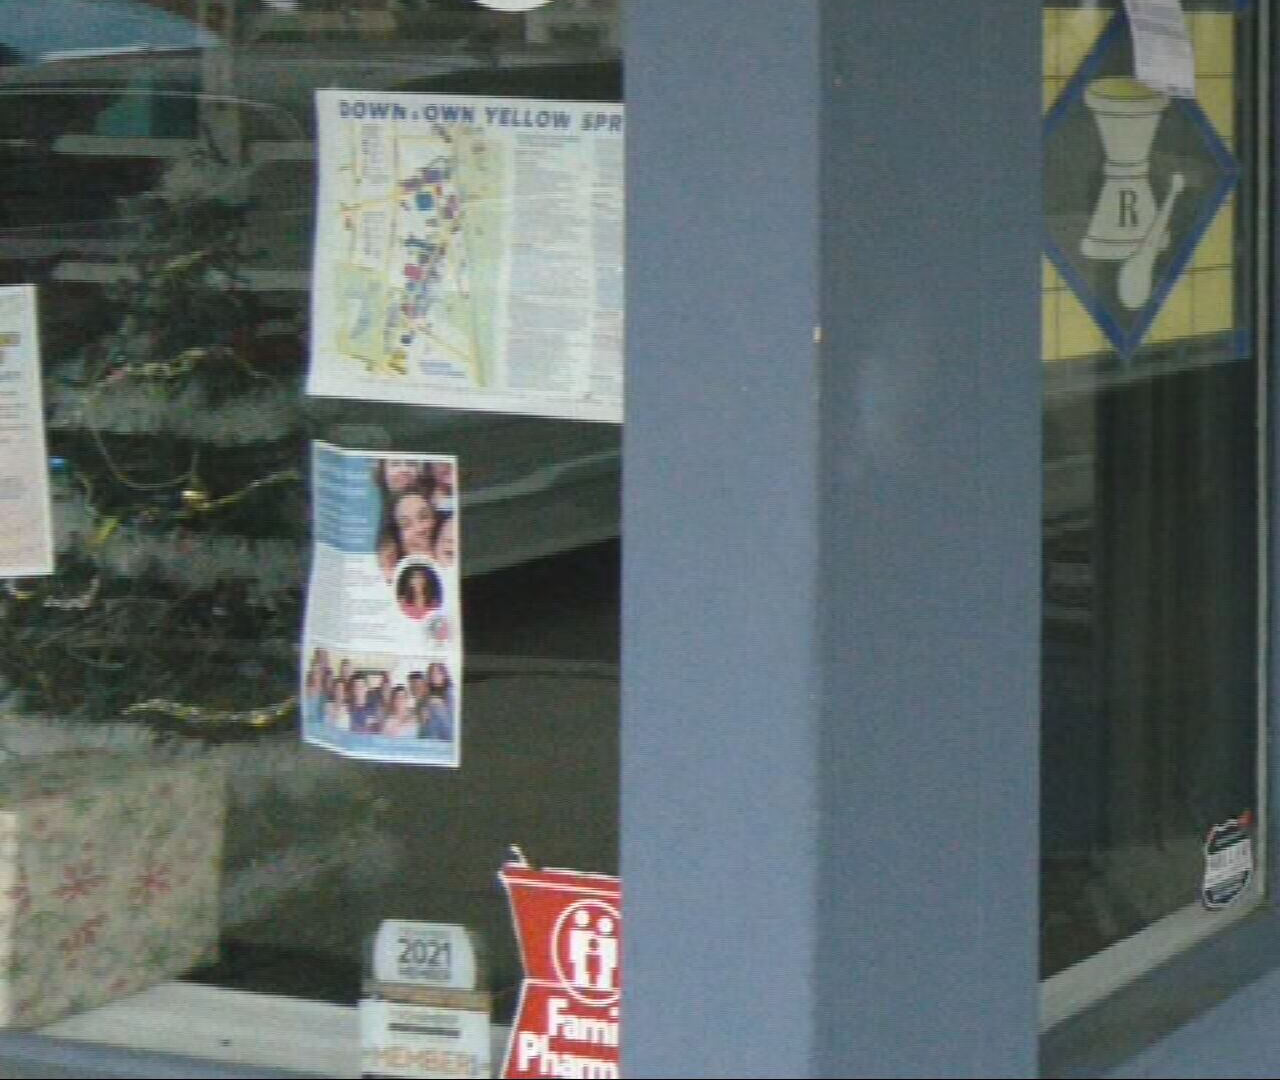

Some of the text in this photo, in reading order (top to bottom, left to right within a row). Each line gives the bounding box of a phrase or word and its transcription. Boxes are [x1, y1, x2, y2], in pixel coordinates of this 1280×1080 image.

[339, 100, 475, 123] DOWNOWN
[484, 106, 571, 129] YELLOW
[397, 937, 451, 966] 2021
[548, 997, 619, 1046] Fami
[518, 1031, 619, 1078] Pharm
